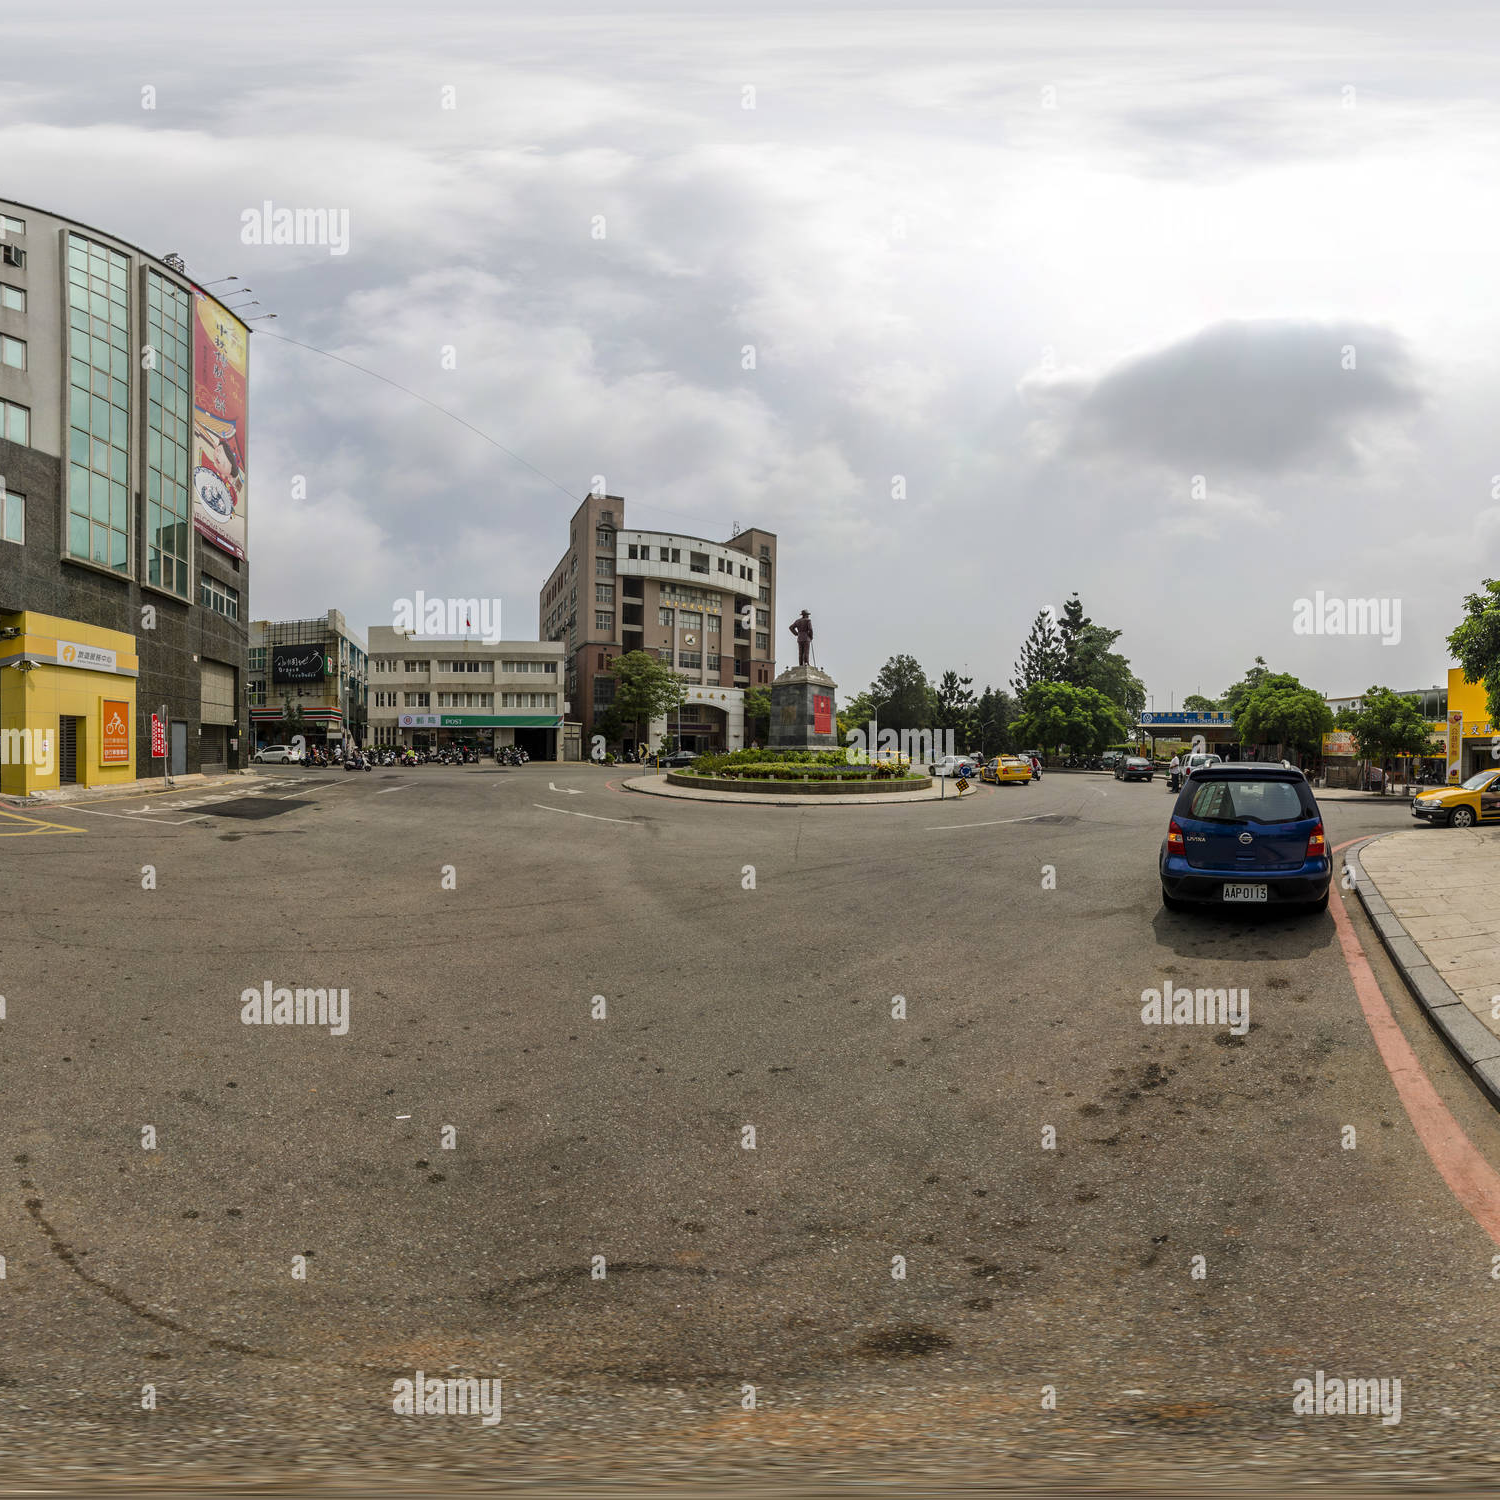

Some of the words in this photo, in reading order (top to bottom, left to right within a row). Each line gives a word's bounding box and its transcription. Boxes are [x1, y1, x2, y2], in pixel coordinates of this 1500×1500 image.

[77, 650, 112, 663] 旅遊服務中心
